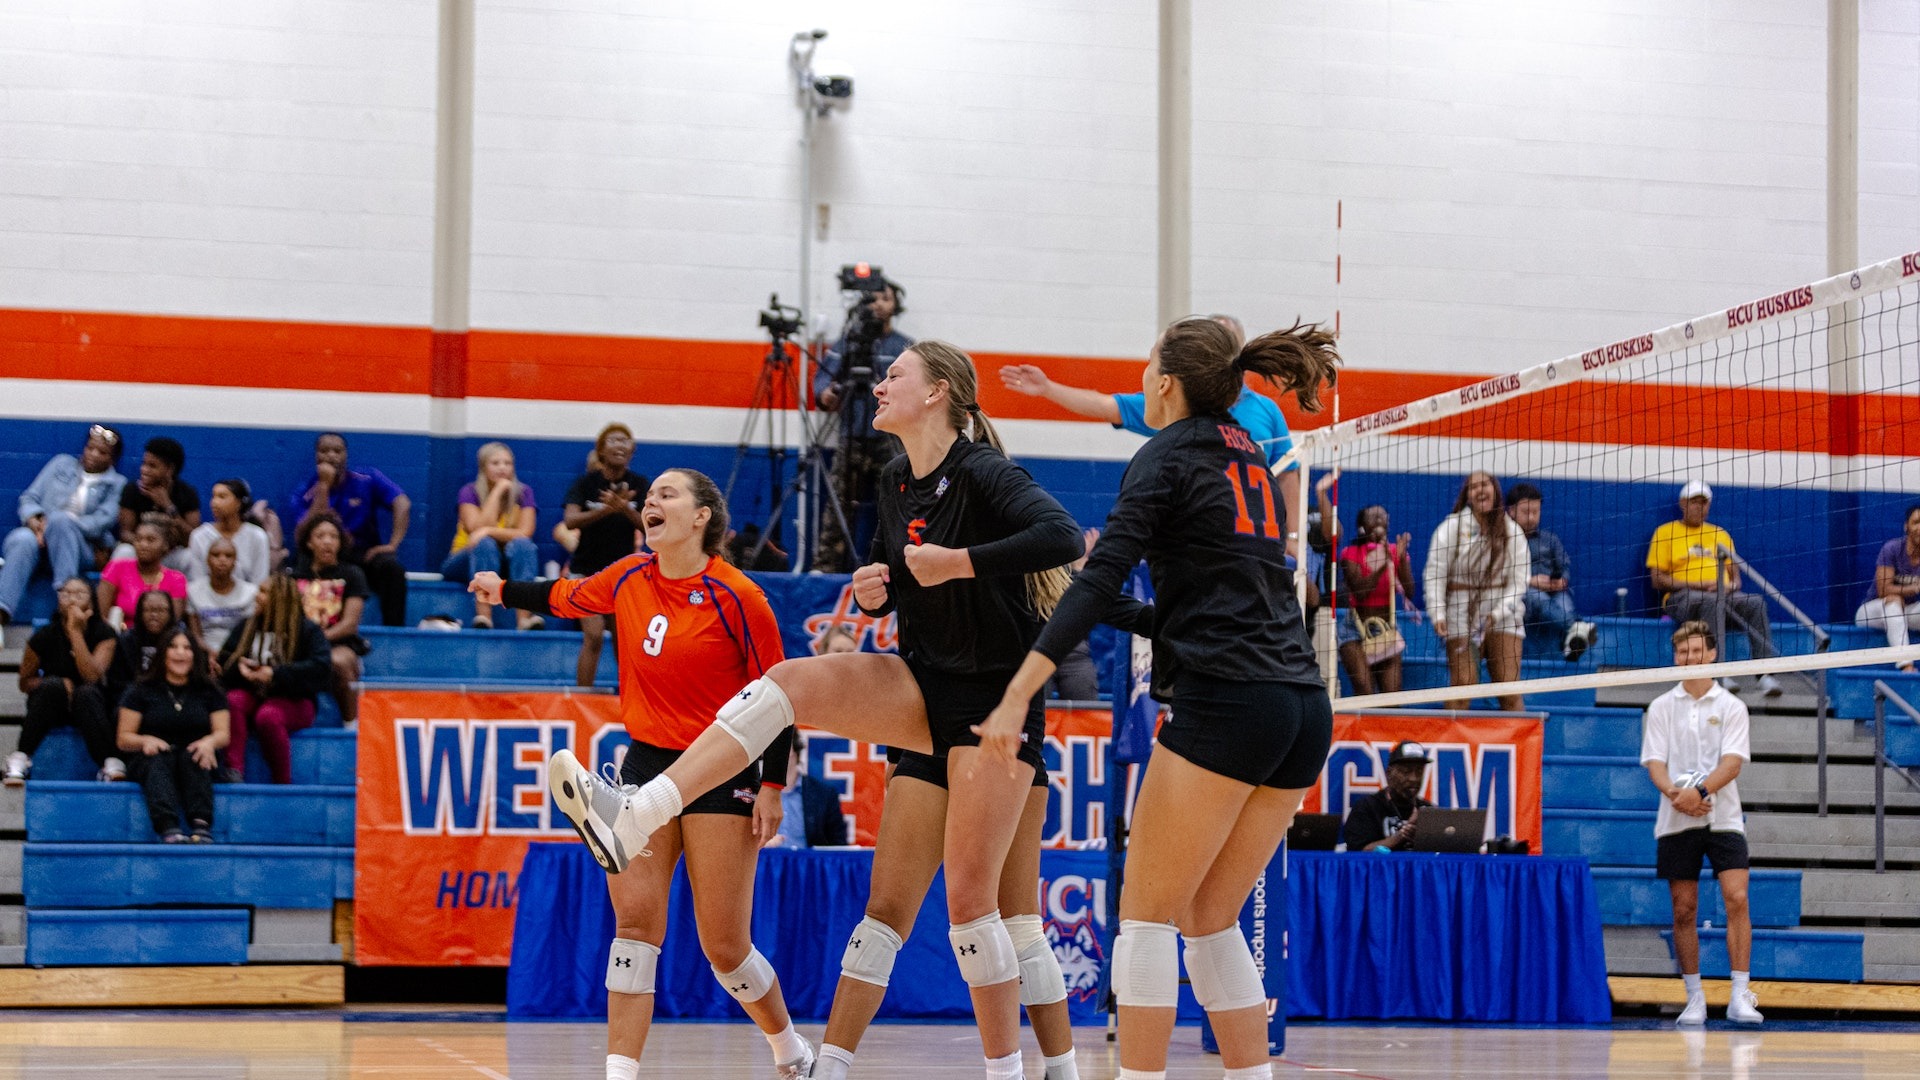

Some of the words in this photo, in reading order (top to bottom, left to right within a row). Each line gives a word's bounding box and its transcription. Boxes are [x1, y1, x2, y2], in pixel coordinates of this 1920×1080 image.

[1902, 253, 1920, 277] HC
[1726, 301, 1754, 329] HCU
[1757, 285, 1814, 320] HUSKIES
[1581, 347, 1606, 371] HCU
[1606, 333, 1654, 363] HUSKIES
[1460, 385, 1479, 405] HCU
[1481, 372, 1521, 399] HUSKIES
[1217, 424, 1256, 453] HCU
[1224, 461, 1280, 539] 17
[642, 613, 669, 657] 9
[436, 871, 520, 908] HOM
